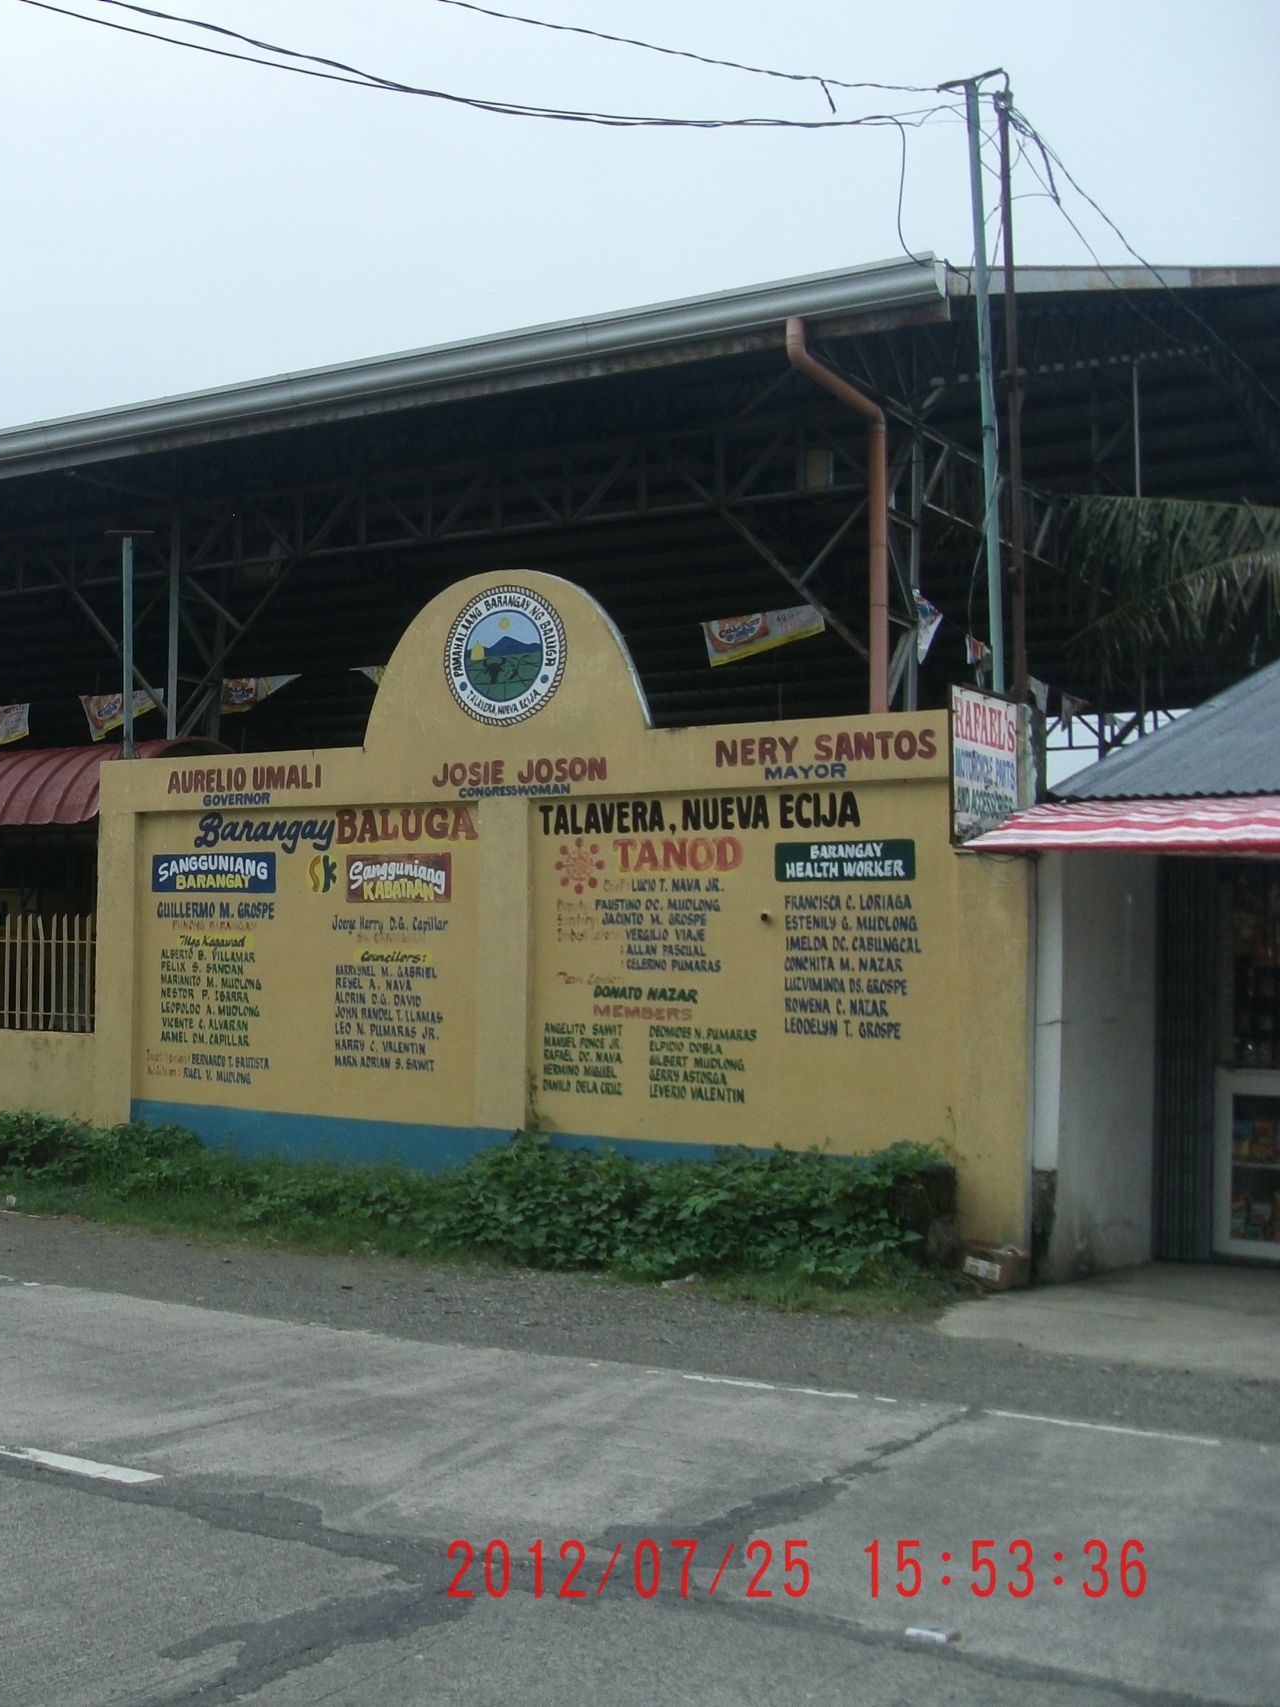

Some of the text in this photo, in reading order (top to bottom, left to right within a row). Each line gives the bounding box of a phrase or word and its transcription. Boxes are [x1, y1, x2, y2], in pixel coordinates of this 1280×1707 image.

[452, 607, 483, 677] PAMAHALAANG
[484, 595, 531, 611] BARANGAY
[530, 607, 545, 621] NG
[497, 703, 519, 716] NUEVA
[519, 689, 541, 710] ECIJA
[715, 729, 937, 768] NERY SANTOS
[167, 764, 321, 795] AURELIO UMALI
[432, 756, 607, 787] JOSIE JOSON
[764, 763, 847, 780] MAYOR
[458, 783, 571, 798] CONGRESSWOMAN
[203, 792, 270, 807] GOVERNOR
[682, 794, 769, 831] NUEVA
[780, 791, 861, 829] ECIJA
[194, 807, 479, 854] Barangay BALUGA
[613, 836, 744, 872] TANOD
[810, 842, 884, 860] BARANGAY
[158, 855, 268, 882] SANGGUNIANG
[349, 859, 446, 895] Sangguniang
[785, 859, 905, 878] HEALTH WORKER
[176, 874, 252, 890] BARANGAY
[363, 878, 435, 901] KABATAAN
[631, 878, 655, 892] LUCIO
[659, 878, 668, 892] T.
[672, 878, 701, 892] NAVA
[705, 878, 724, 892] JR.
[157, 901, 275, 920] GUILLERMO M. GROSPE
[595, 899, 641, 911] FAUSTINO
[784, 894, 912, 911] FRANCISCA C. LORIAGA
[602, 913, 643, 925] JACINTO
[650, 914, 663, 925] M.
[857, 915, 917, 932] MUDLONG
[675, 929, 705, 942] VIAJE
[786, 935, 828, 951] IMELDA
[852, 936, 922, 953] CABUNGCAL
[161, 949, 193, 960] ALBERTO
[161, 961, 186, 972] FELIX
[672, 959, 721, 972] PUMARAS
[784, 955, 903, 972] CONCHITA M. NAZAR
[397, 966, 438, 979] GABRIEL
[160, 988, 194, 1000] NESTOR
[386, 980, 412, 992] NAVA
[593, 985, 699, 1004] DONATO NAZAR
[867, 979, 907, 996] GROSPE
[394, 994, 422, 1007] DAVID
[785, 997, 889, 1017] ROWENA C. NAZAR
[218, 1005, 260, 1018] MUDLONG
[335, 1006, 358, 1019] JOHN
[593, 1004, 693, 1021] MEMBERS
[162, 1017, 194, 1029] VICENTE
[335, 1021, 351, 1035] LEO
[370, 1023, 417, 1038] PUMARAS
[544, 1022, 586, 1036] ANGELITO
[843, 1020, 853, 1038] T.
[859, 1022, 902, 1040] GROSPE
[707, 1028, 757, 1042] PUMARAS
[382, 1041, 426, 1055] VALENTIN
[595, 1051, 623, 1065] NAVA
[690, 1085, 746, 1104] VALENTIN
